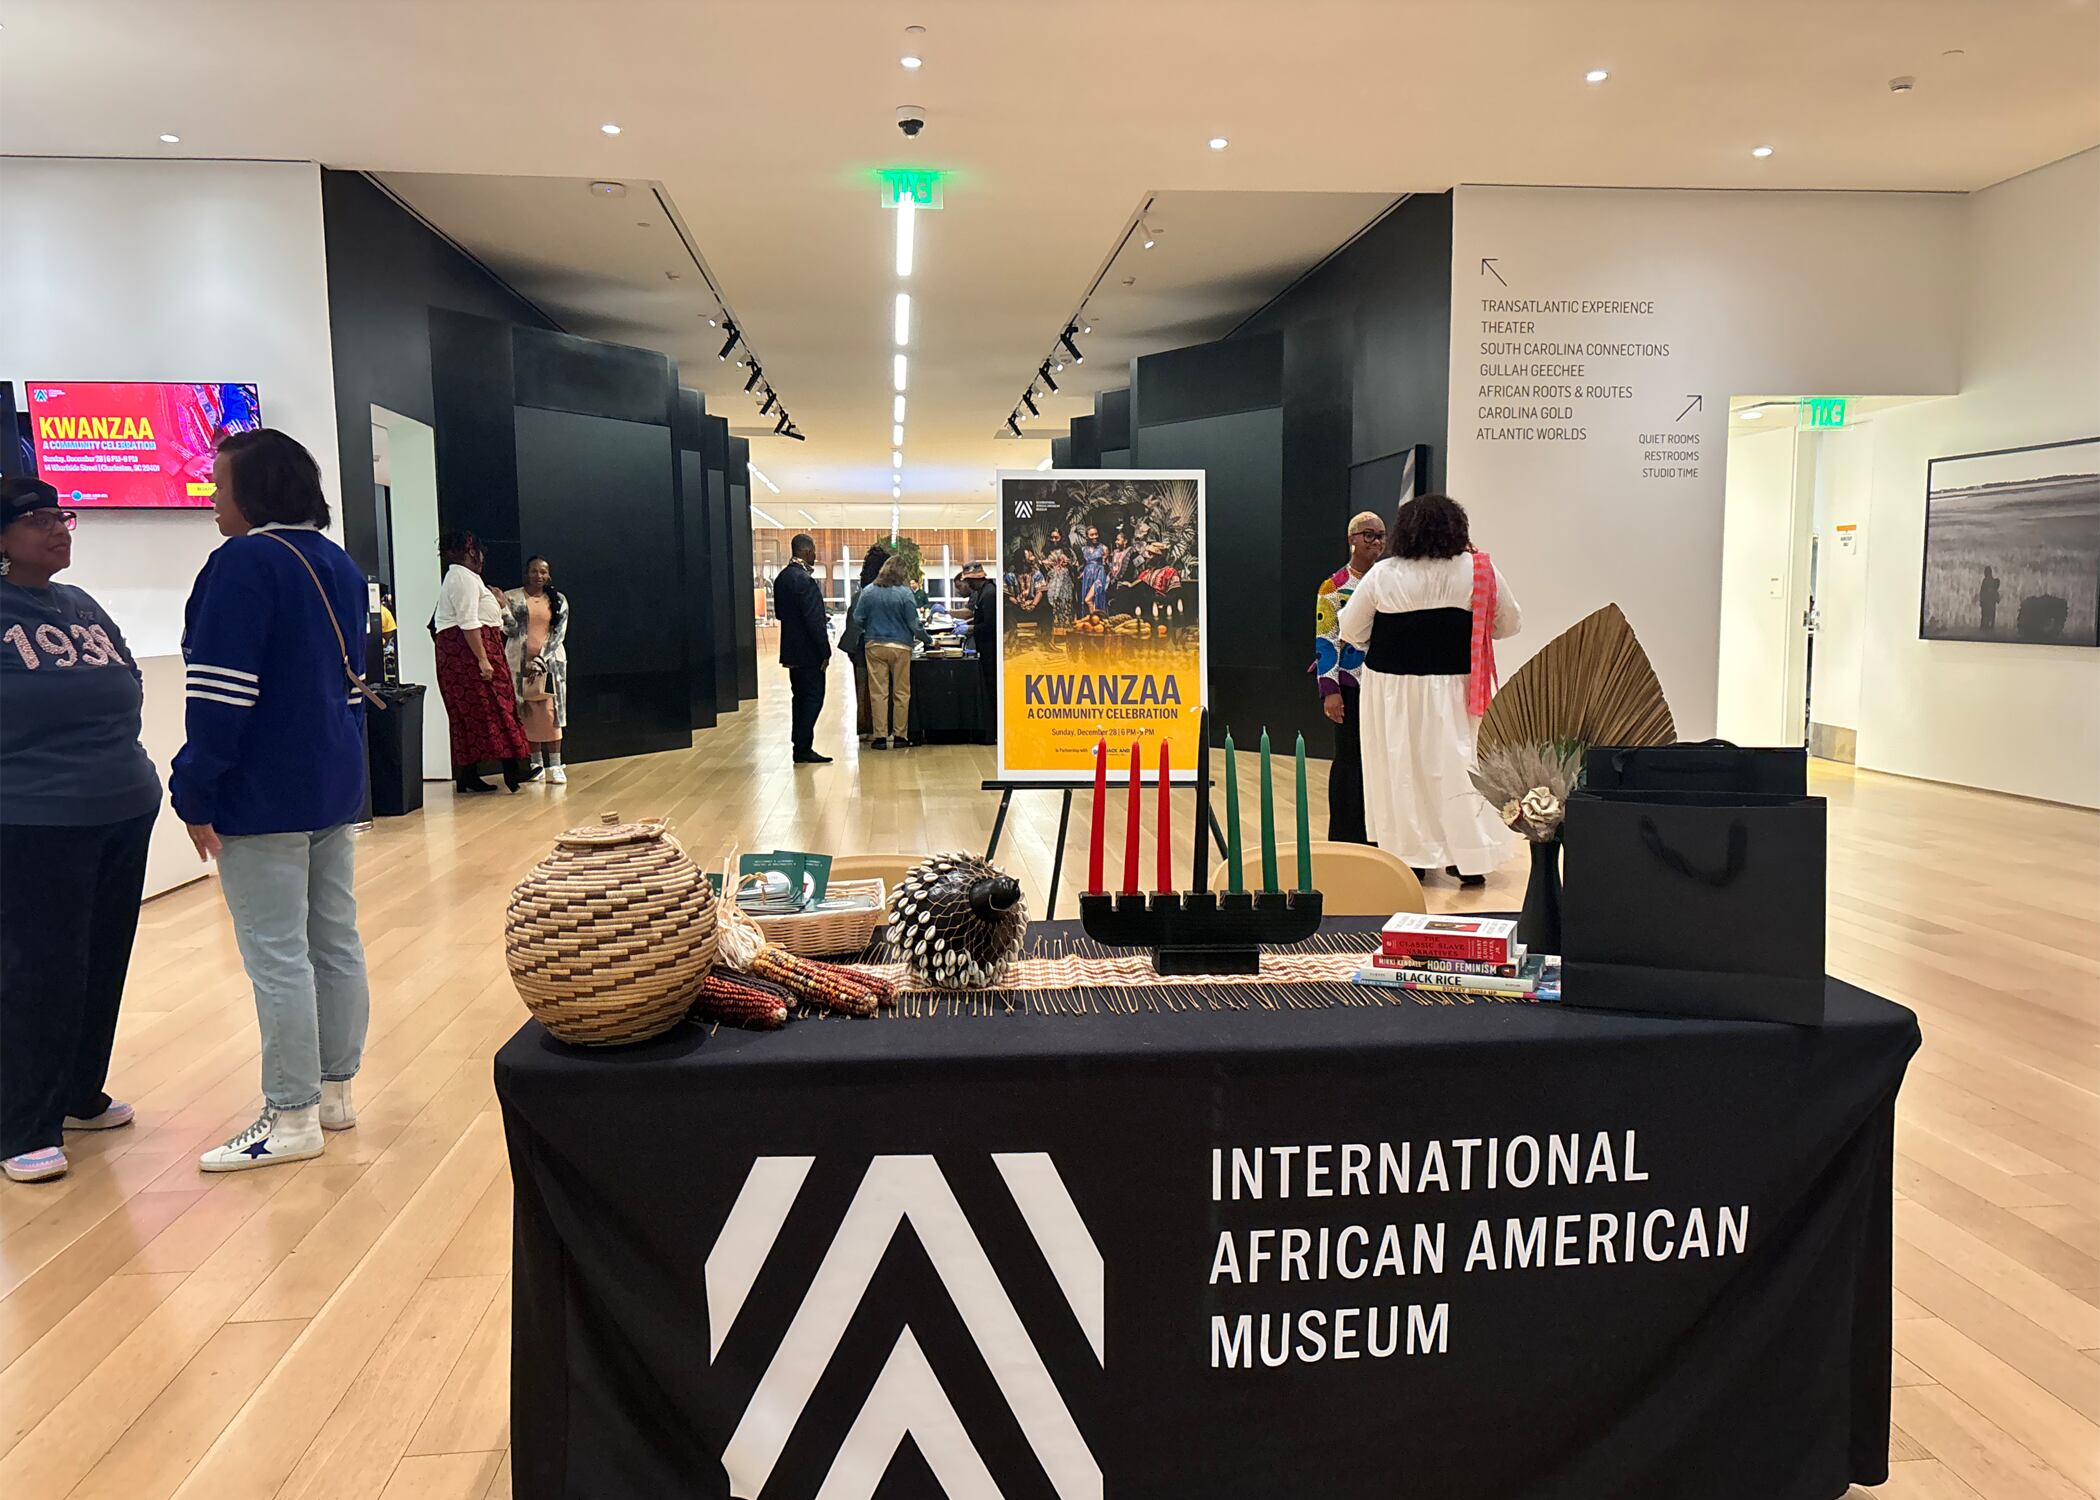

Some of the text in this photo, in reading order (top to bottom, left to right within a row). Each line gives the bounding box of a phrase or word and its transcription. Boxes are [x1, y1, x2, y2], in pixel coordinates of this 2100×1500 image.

[1481, 299, 1655, 314] TRANSATLANTIC EXPERIENCE
[1481, 321, 1535, 334] THEATER
[1480, 342, 1670, 357] SOUTH CAROLINA CONNECTIONS
[1480, 364, 1585, 377] GULLAH GEECHEE
[1478, 385, 1633, 399] AFRICAN ROOTS & ROUTES
[1478, 407, 1573, 419] CAROLINA GOLD
[38, 416, 154, 440] KWANZAA
[1476, 428, 1587, 441] ATLANTIC WORLDS
[42, 441, 157, 450] A COMMUNITY CELEBRATION
[1639, 434, 1700, 445] QUIET ROOMS
[1644, 451, 1700, 461] RESTROOMS
[1642, 468, 1699, 478] STUDIO TIME
[1025, 674, 1182, 706] KWANZAA
[1027, 708, 1179, 720] A COMMUNITY CELEBRATION
[1051, 728, 1076, 737] Sunday,
[1077, 728, 1108, 736] December
[1399, 941, 1435, 950] CLASSIC
[1439, 943, 1465, 951] SLAVE
[1406, 948, 1459, 957] NARRATIVES
[1379, 958, 1498, 975] MIKKI KENDALL HOOD FEMINISM
[1395, 971, 1435, 984] BLACK
[1435, 975, 1462, 986] RICE
[1211, 1130, 1649, 1201] INTERNATIONAL
[1209, 1206, 1750, 1285] AFRICAN AMERICAN
[1211, 1303, 1449, 1369] MUSEUM
